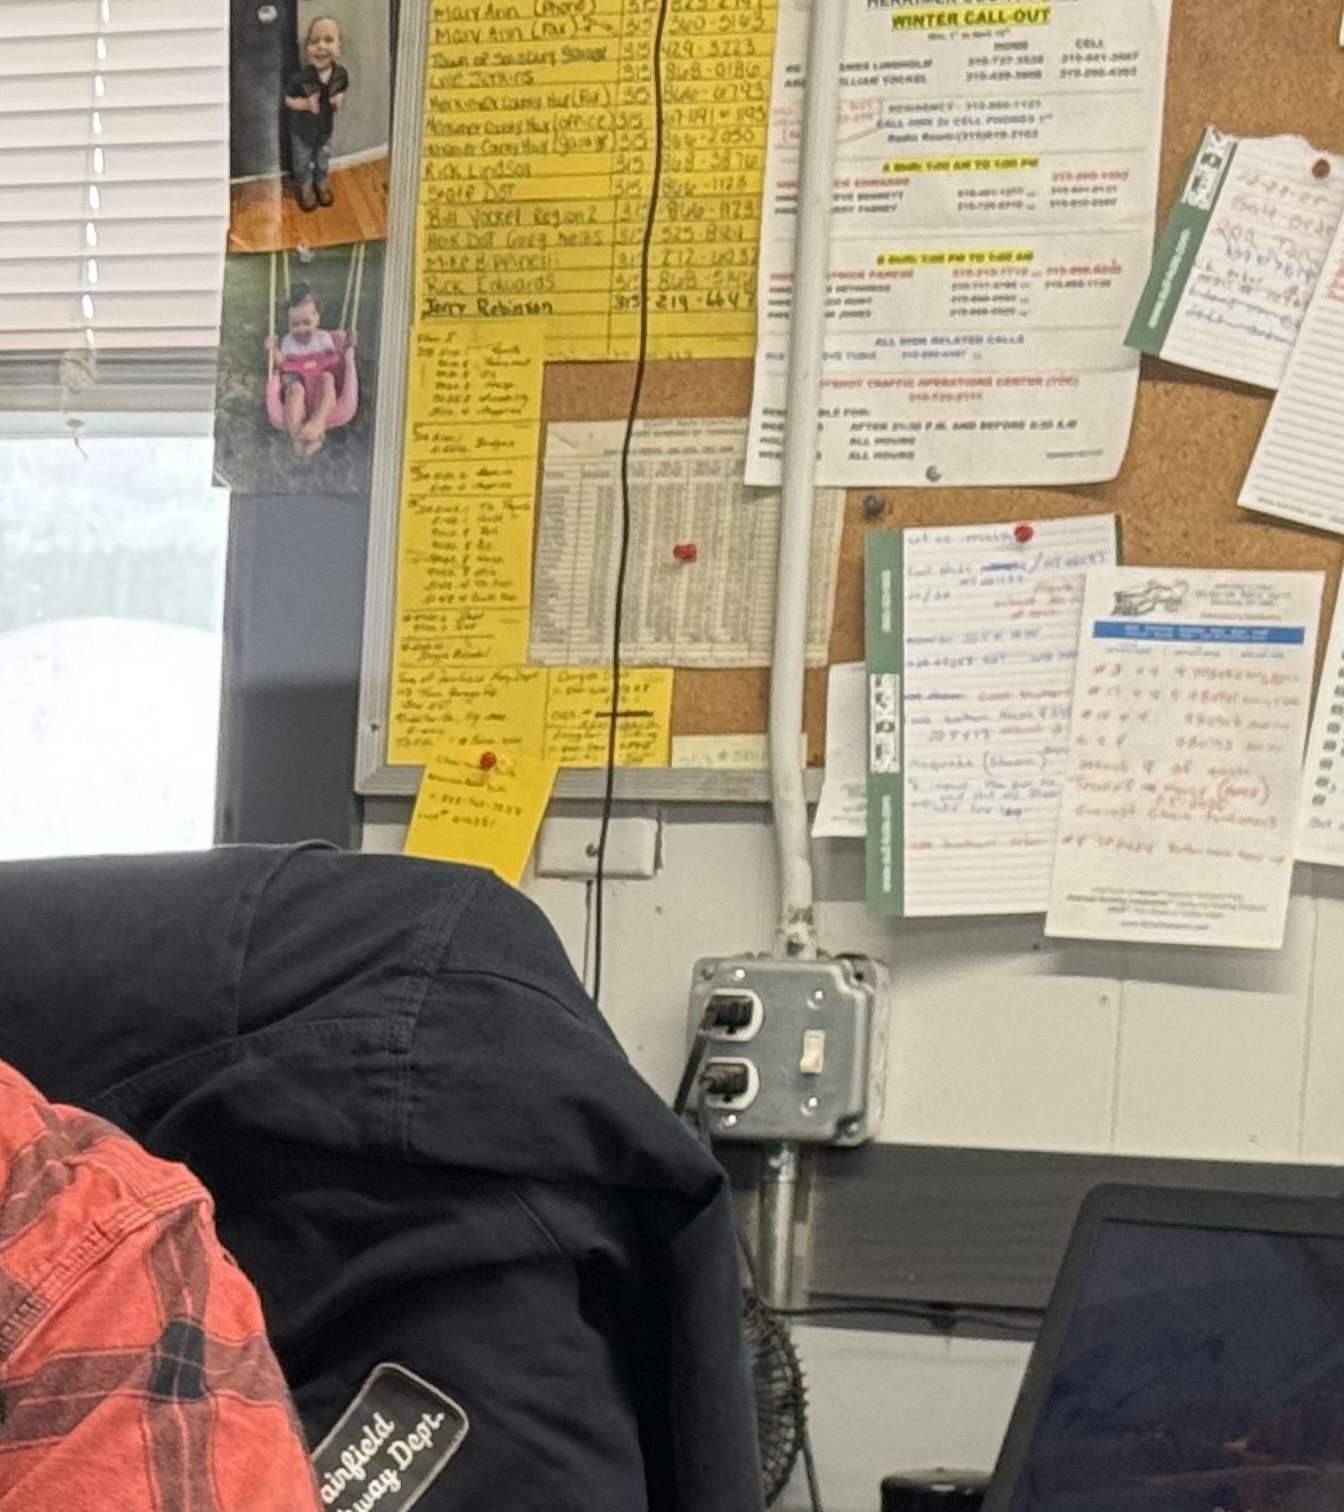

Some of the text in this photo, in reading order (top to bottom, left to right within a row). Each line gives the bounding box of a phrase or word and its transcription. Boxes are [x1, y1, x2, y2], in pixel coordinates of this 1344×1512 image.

[891, 12, 959, 29] WINTER
[319, 1411, 395, 1504] airfield
[386, 1411, 446, 1471] Dept.
